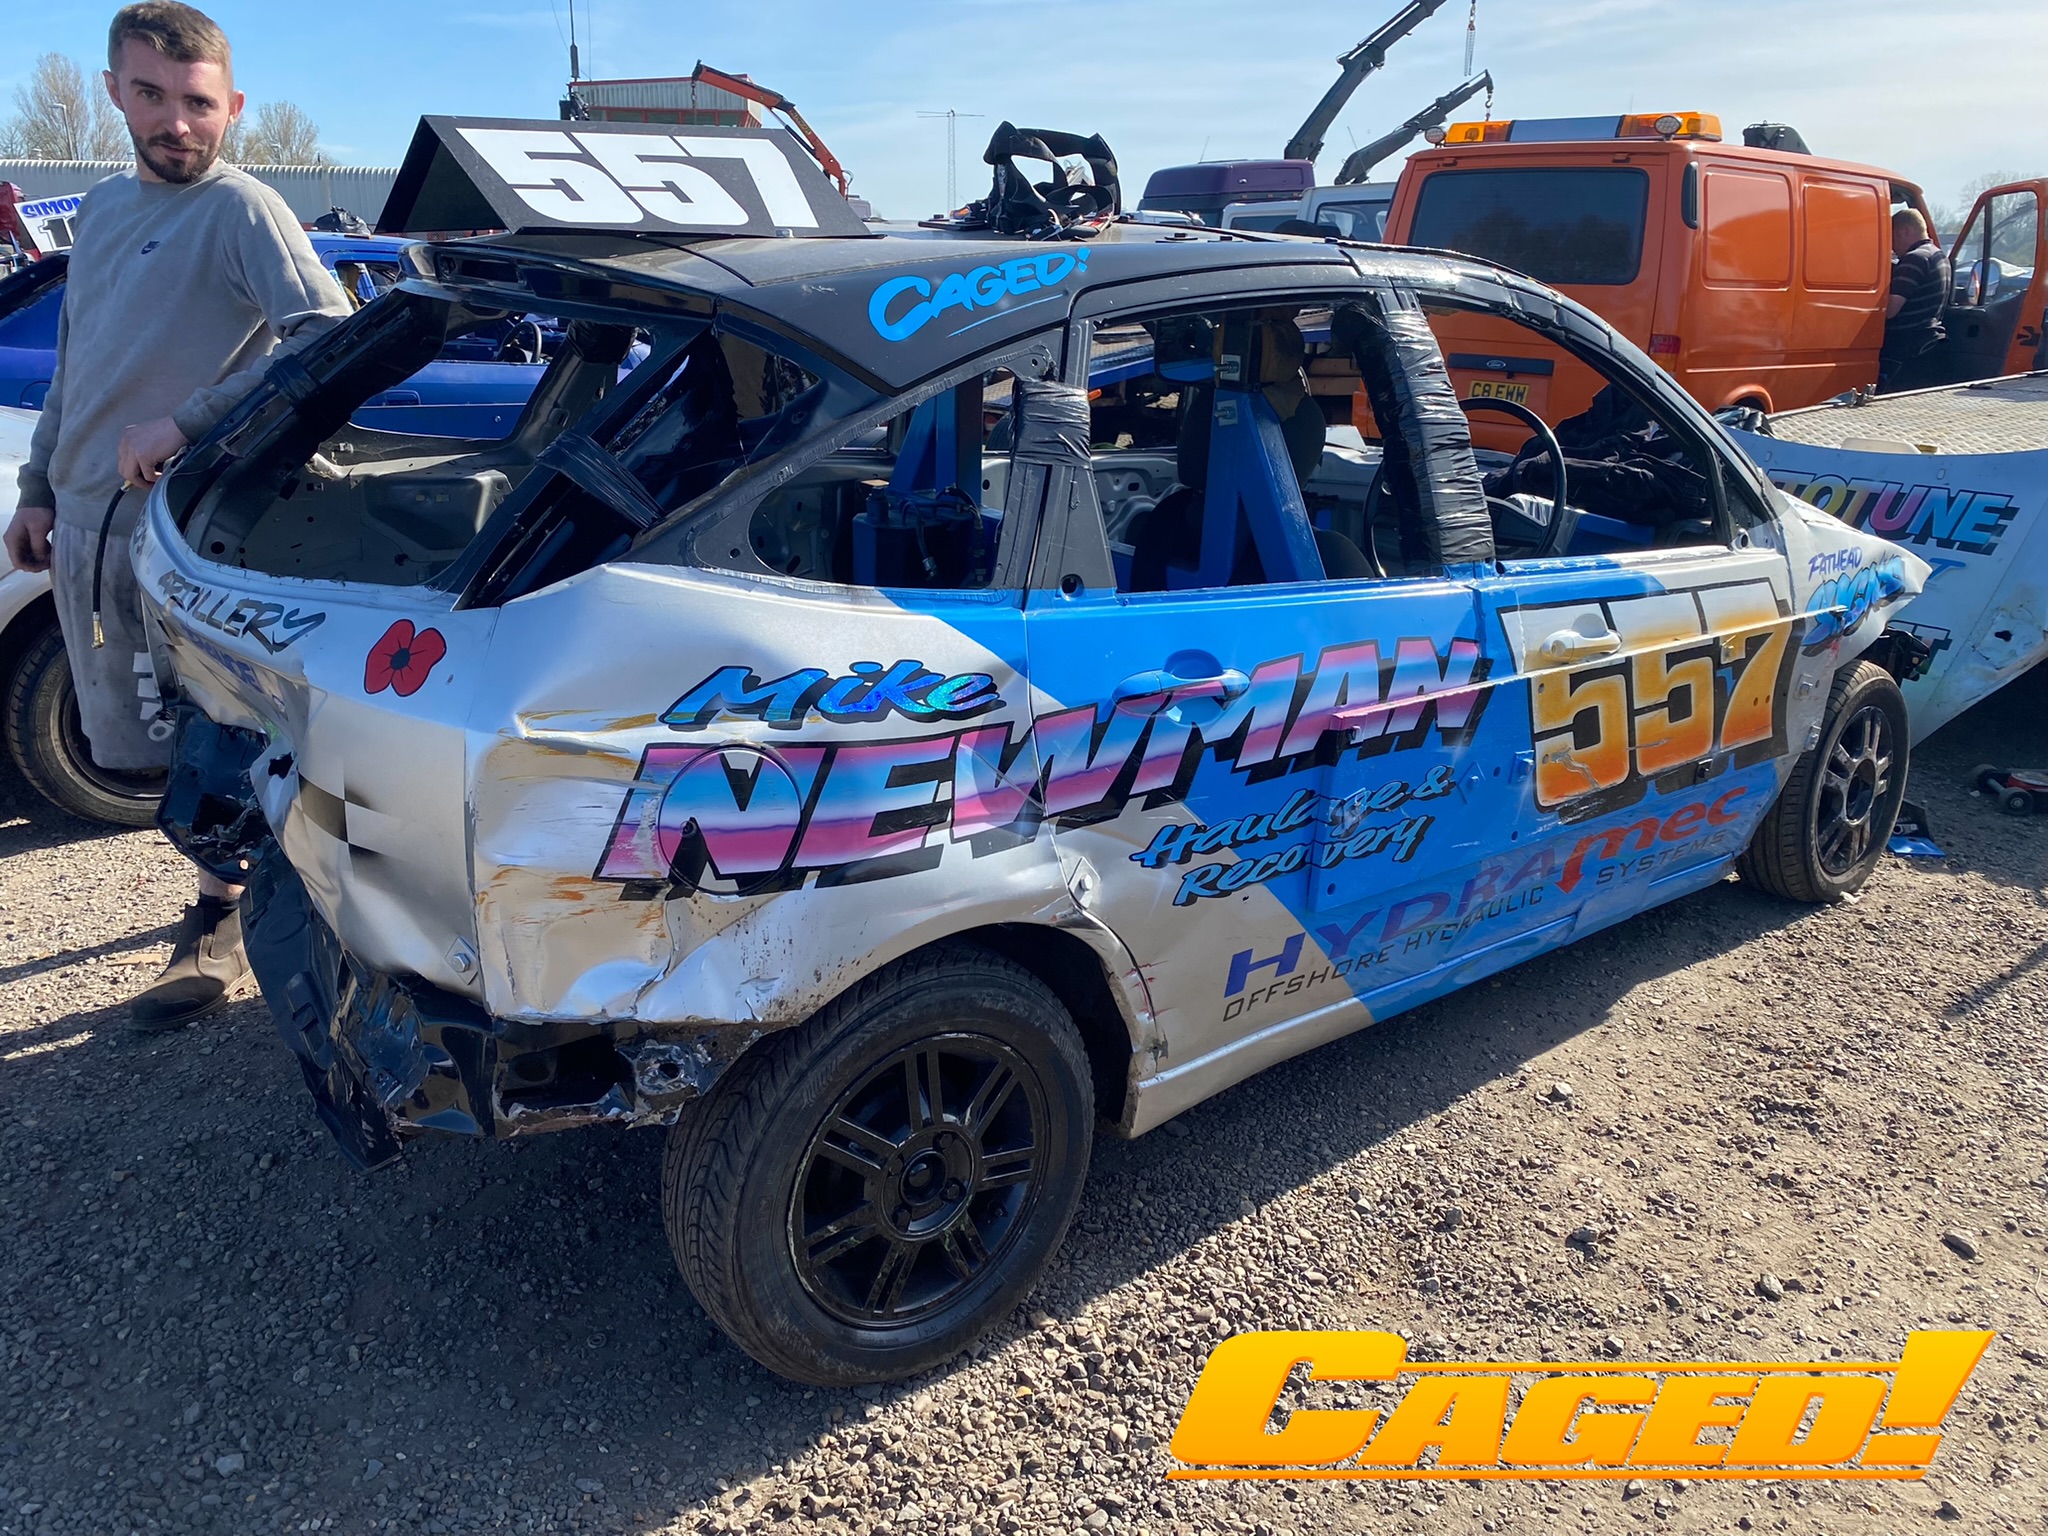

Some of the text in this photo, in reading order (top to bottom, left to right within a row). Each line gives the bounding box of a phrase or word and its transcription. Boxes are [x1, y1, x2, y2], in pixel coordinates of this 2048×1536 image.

[456, 128, 820, 228] 557
[868, 246, 1091, 342] CAGED!
[1808, 546, 1863, 581] FATHEAD
[659, 659, 1006, 731] Mike
[1496, 577, 1793, 825] 557
[593, 636, 1494, 900] NEWMAN
[1407, 764, 1457, 803] &
[1173, 813, 1435, 906] Recovery
[1222, 829, 1727, 1023] OFFSHORE HYDRAULIC SYSTEMS
